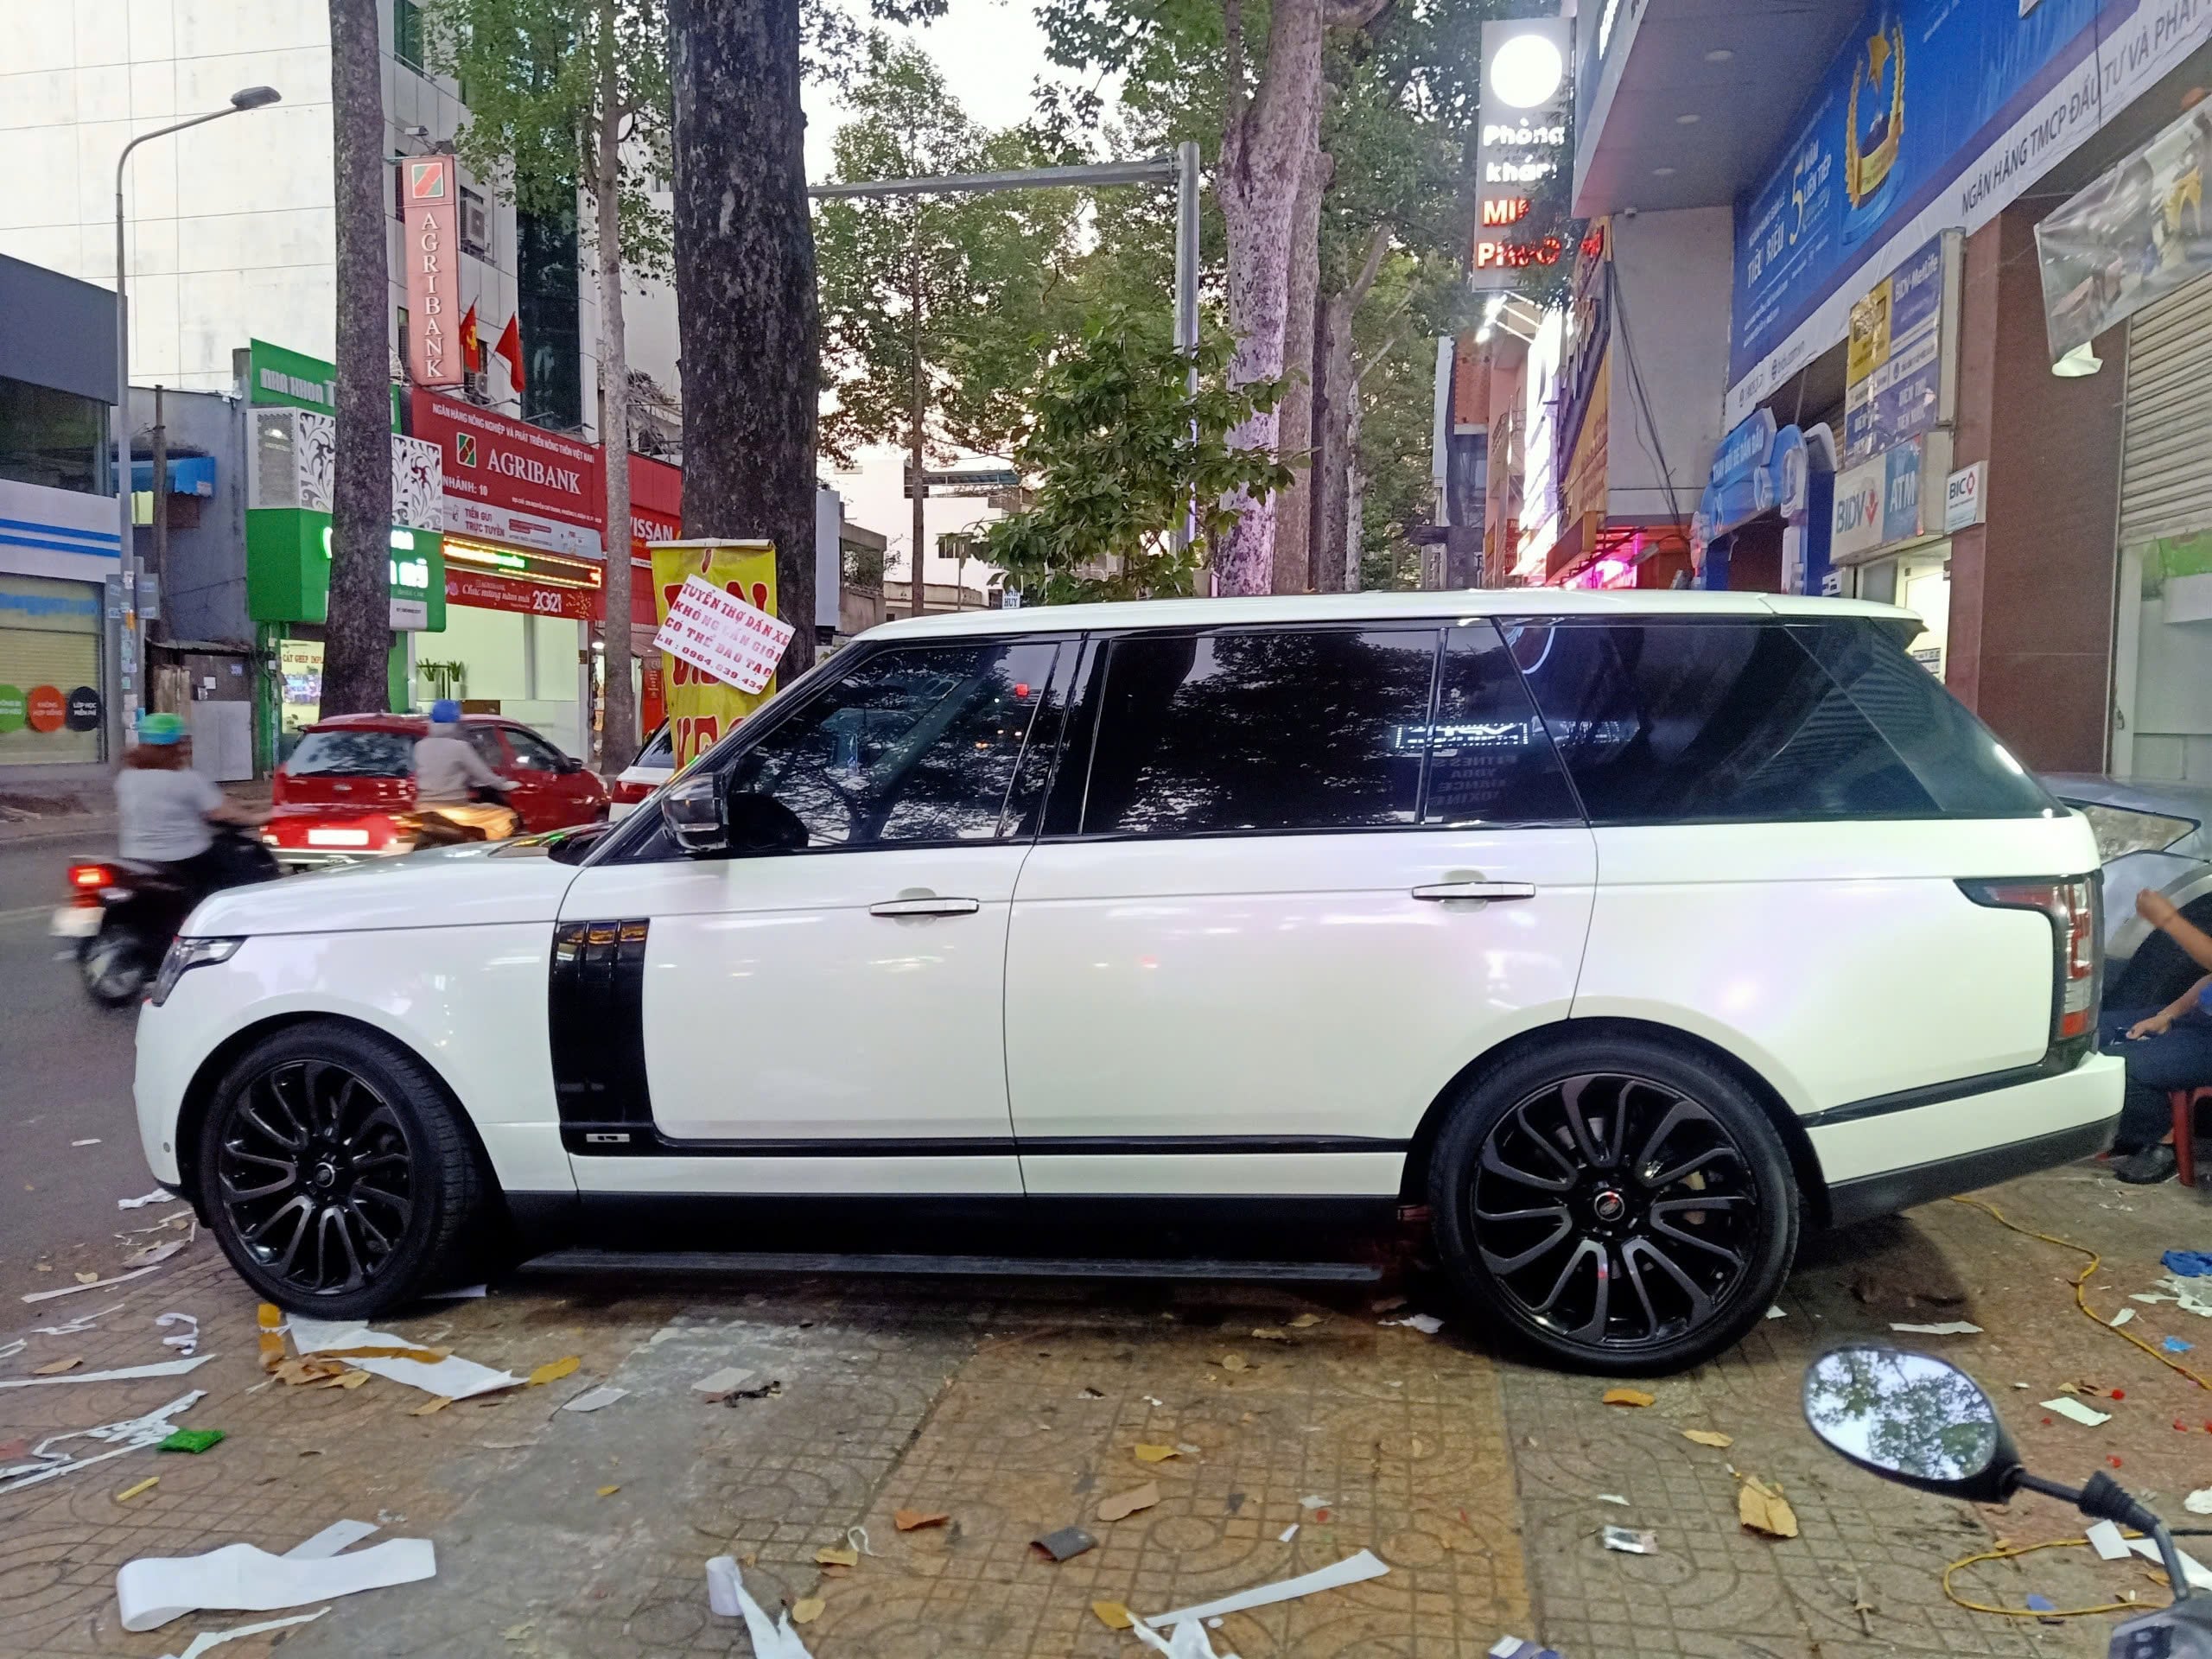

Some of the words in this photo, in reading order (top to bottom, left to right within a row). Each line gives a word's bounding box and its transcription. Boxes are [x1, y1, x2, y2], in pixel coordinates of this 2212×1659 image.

[1993, 149, 2028, 189] HÀNG
[2030, 105, 2066, 156] TMCP
[1789, 153, 1804, 245] 5
[421, 212, 444, 378] AGRIBANK
[442, 474, 477, 494] NHÁNH:
[479, 484, 488, 497] 10
[486, 448, 582, 495] AGRIBANK
[1889, 470, 1916, 513] ATM
[1949, 481, 1966, 500] BIC
[1836, 490, 1866, 533] BIDV
[532, 590, 563, 613] 2021
[673, 601, 720, 631] KHÔNG
[682, 582, 721, 610] TUYỂN
[721, 602, 746, 624] THỢ
[745, 616, 773, 637] DÁN
[772, 629, 791, 646] XE
[1004, 597, 1018, 607] HUY
[664, 617, 683, 632] CÓ
